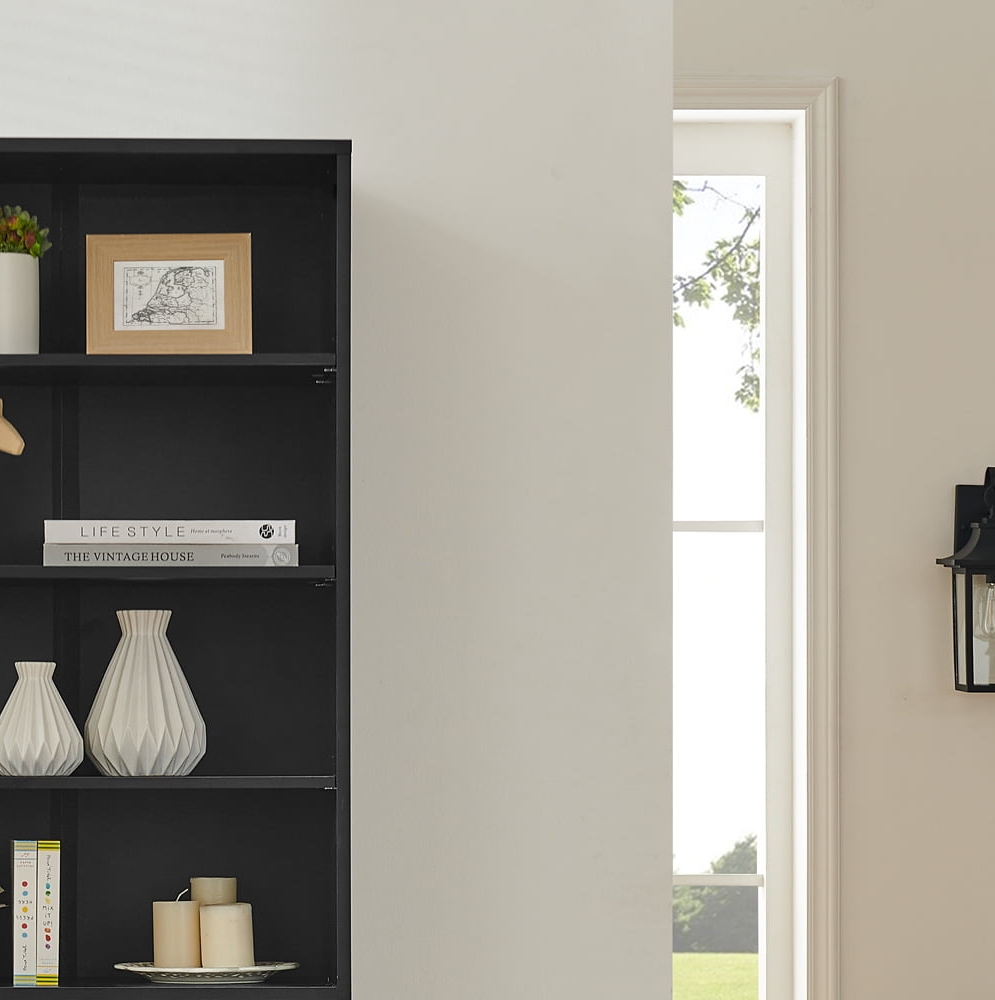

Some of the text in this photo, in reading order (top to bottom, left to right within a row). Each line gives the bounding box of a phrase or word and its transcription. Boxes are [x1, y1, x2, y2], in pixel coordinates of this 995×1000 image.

[80, 526, 121, 538] LIFE
[127, 526, 186, 538] STYLE
[64, 551, 90, 562] THE
[94, 551, 148, 562] VINTAGE
[150, 551, 195, 562] HOUSE
